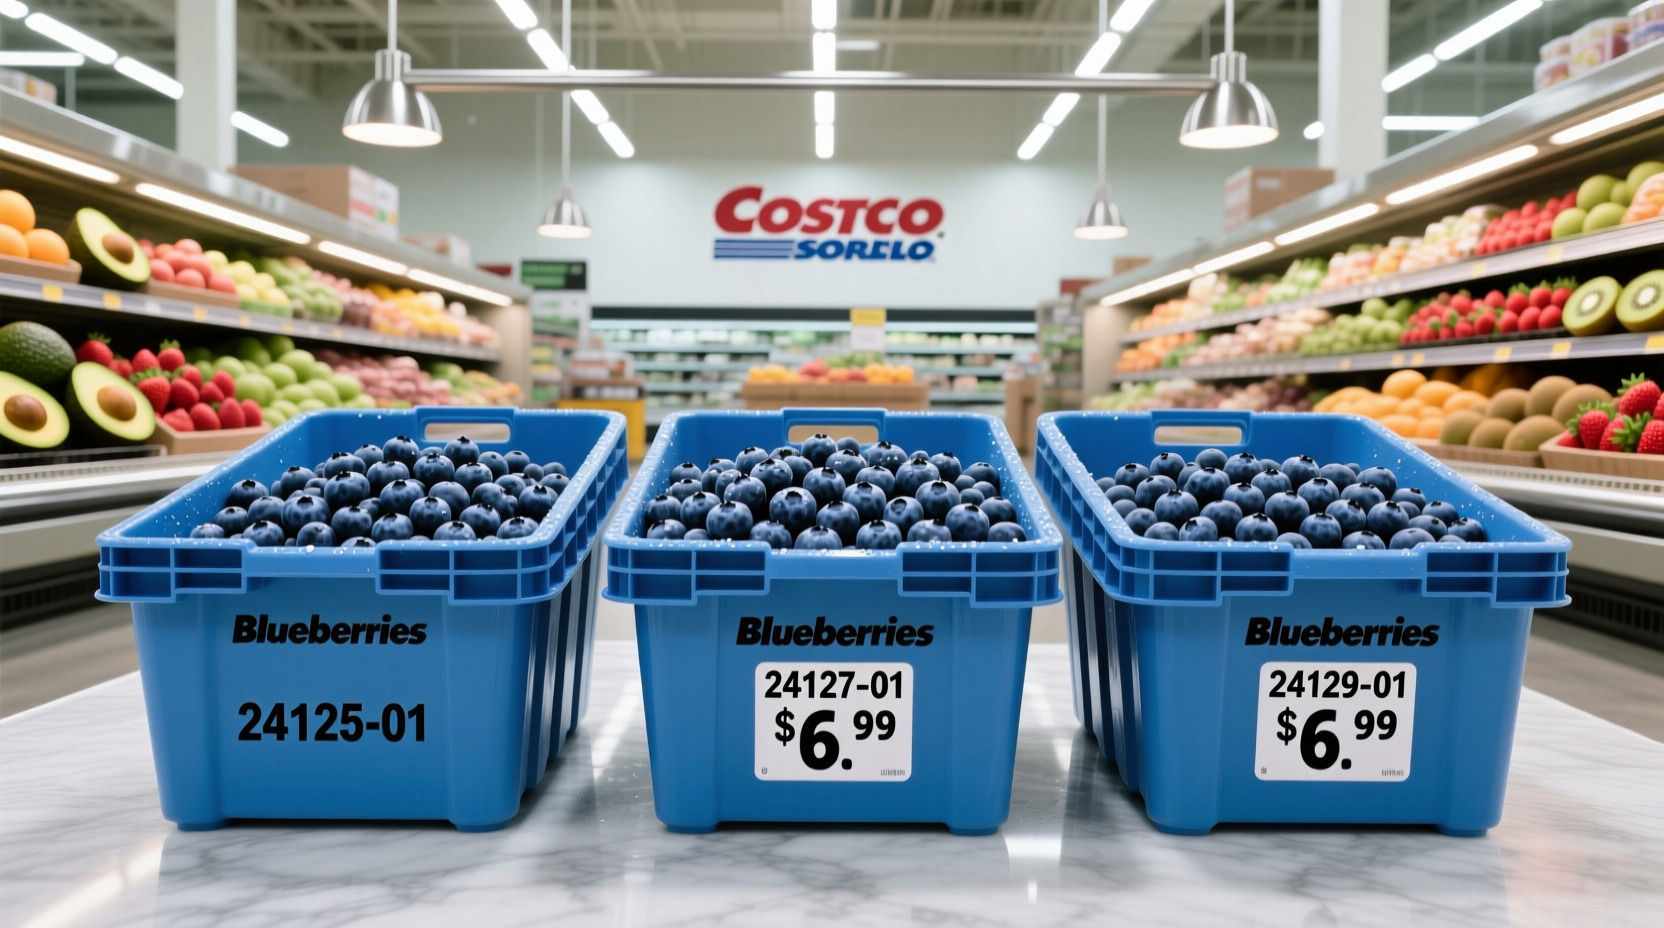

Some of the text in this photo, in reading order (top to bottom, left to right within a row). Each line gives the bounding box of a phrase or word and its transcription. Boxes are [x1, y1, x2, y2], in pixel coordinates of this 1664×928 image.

[232, 613, 428, 645] Blueberries
[735, 615, 935, 647] Blueberries
[1244, 615, 1441, 647] Blueberries
[764, 670, 902, 699] 24127-01
[1268, 669, 1406, 699] 24129-01
[238, 701, 425, 743] 24125-01
